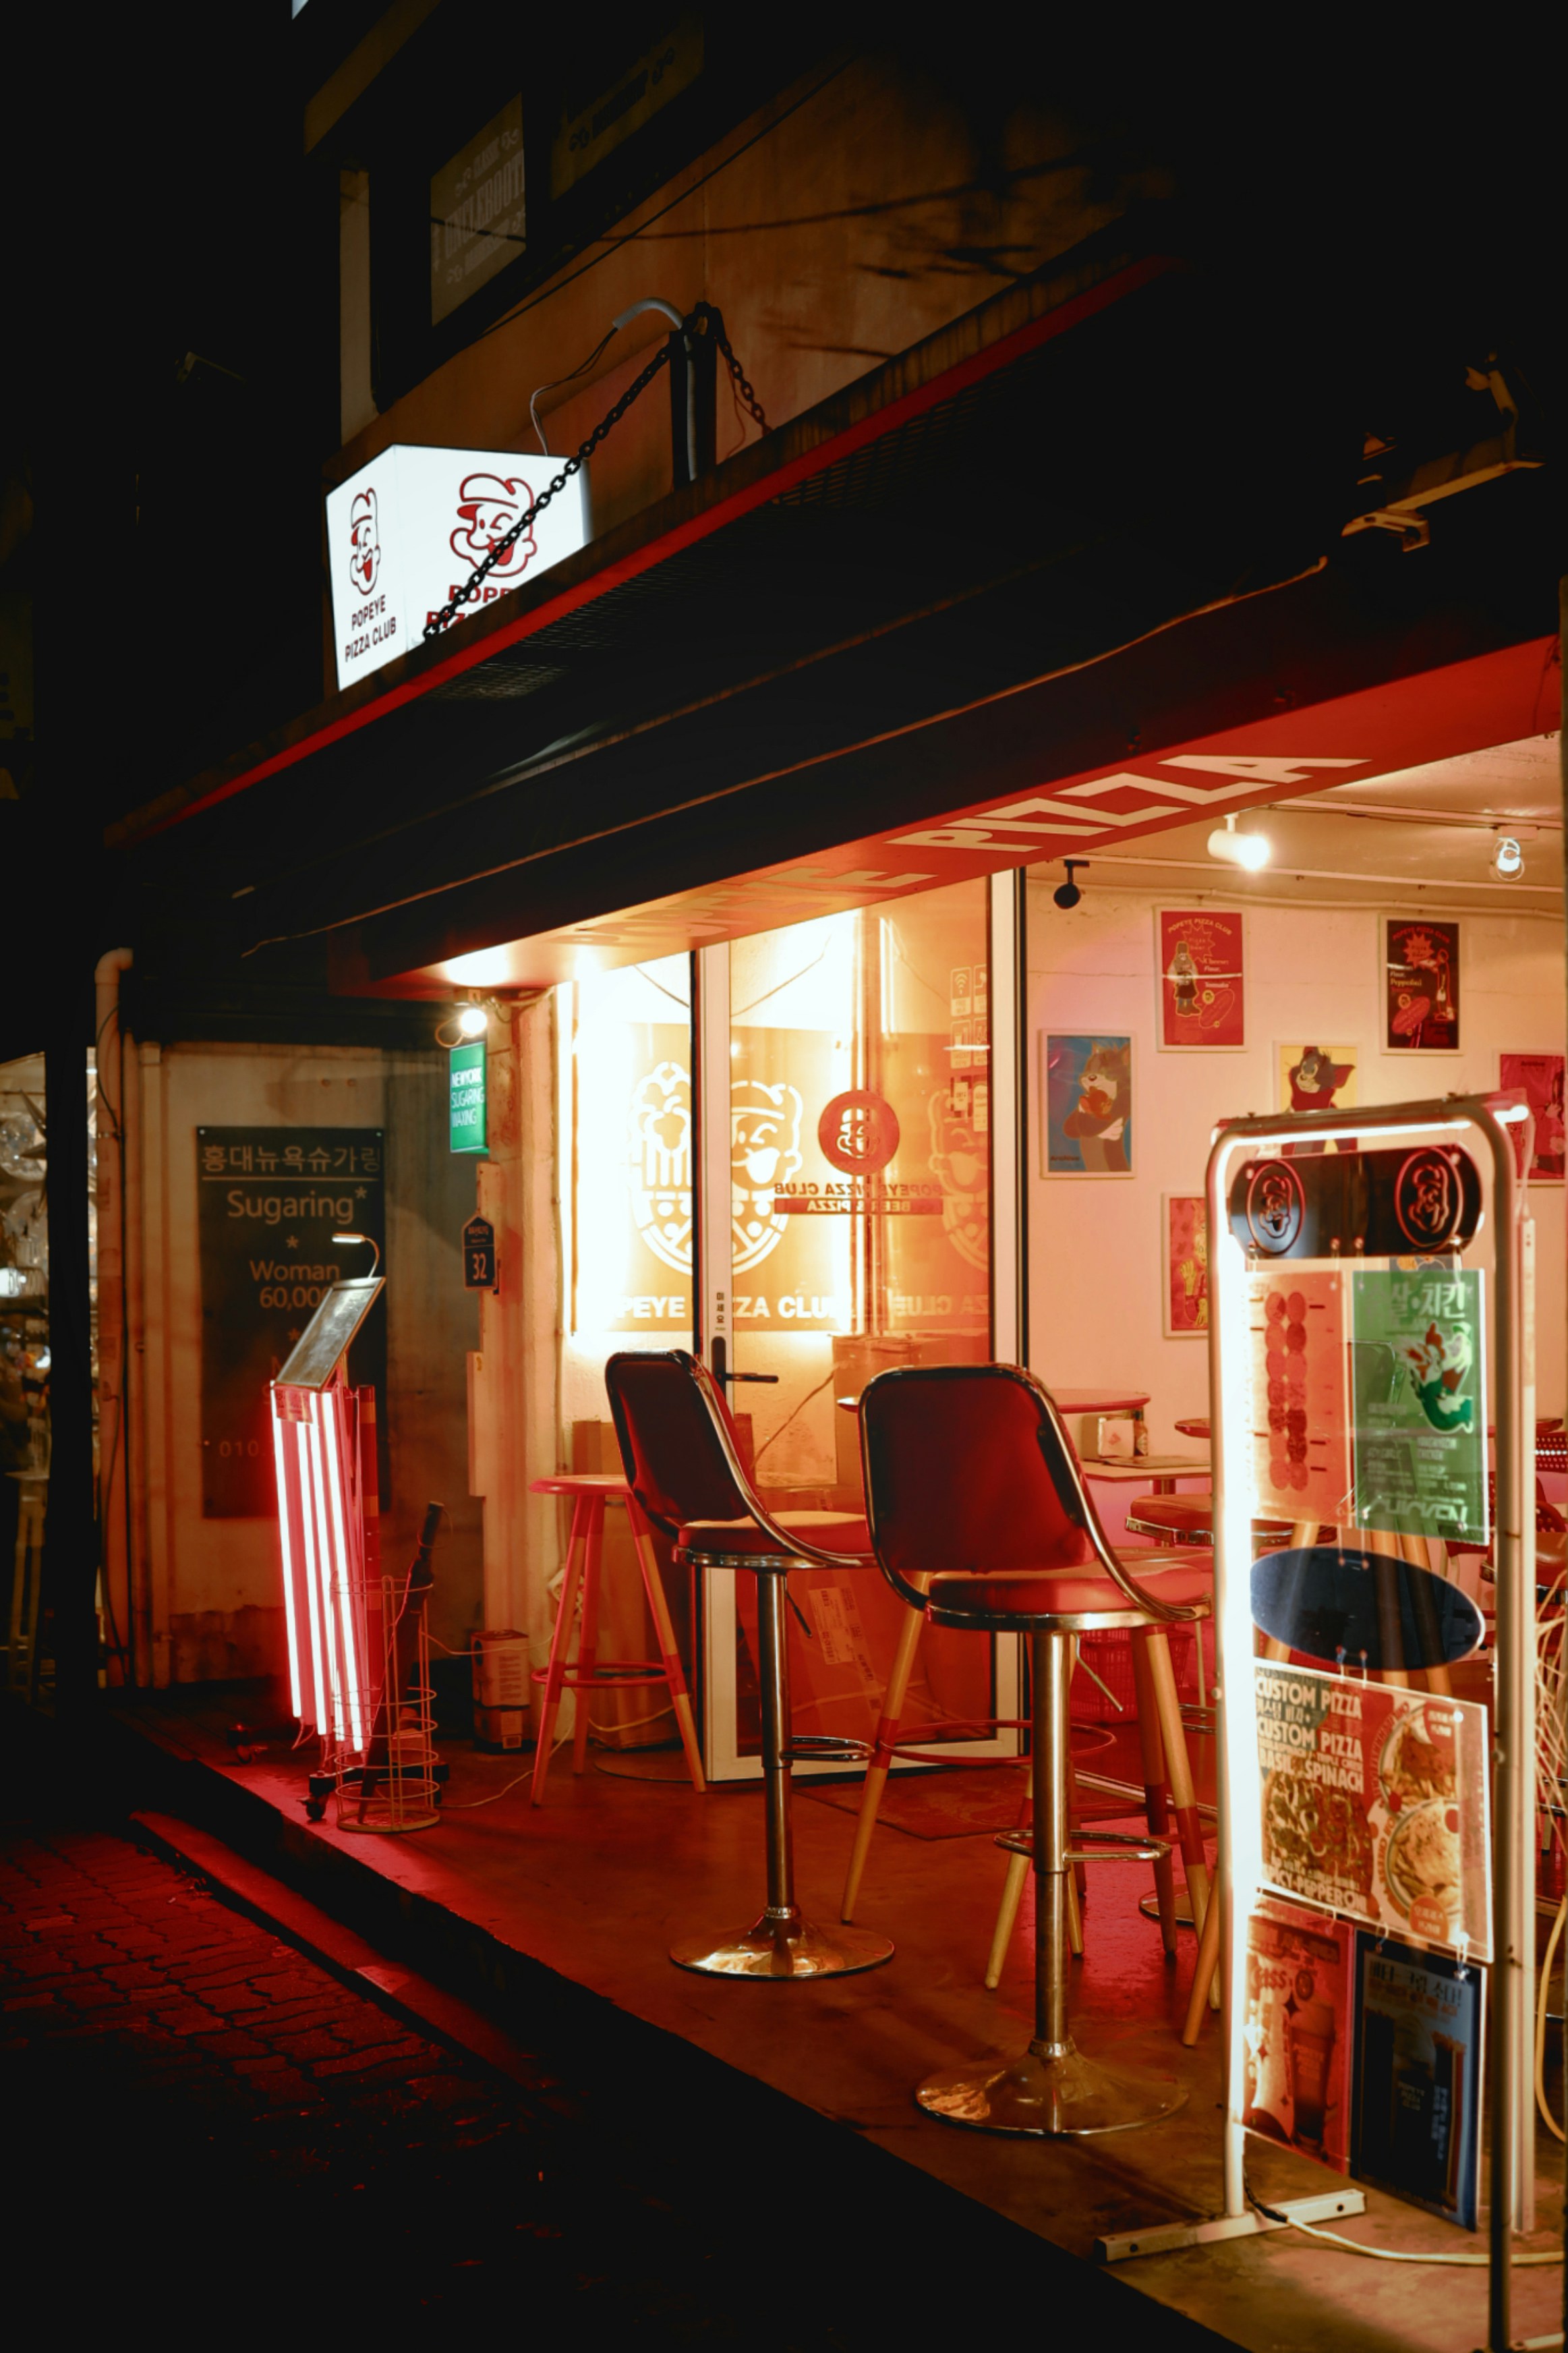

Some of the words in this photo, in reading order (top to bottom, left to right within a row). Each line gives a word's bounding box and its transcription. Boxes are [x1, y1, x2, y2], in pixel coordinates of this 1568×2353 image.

[351, 595, 386, 631] POPEYE
[345, 637, 370, 662] PIZZA
[372, 619, 397, 646] CLUB
[883, 754, 1372, 853] PIZZA
[1215, 922, 1232, 936] CLUB
[451, 1086, 485, 1108] SUGARING
[451, 1108, 477, 1128] WAXING
[202, 1145, 380, 1172] 홍대뉴욕슈가링
[250, 1260, 340, 1282] Woman
[472, 1253, 487, 1280] 32
[616, 1295, 685, 1317] PEYE
[716, 1292, 724, 1323] 미세요
[1256, 1676, 1316, 1708] CUSTOM
[1320, 1690, 1362, 1720] PIZZA
[1257, 1716, 1316, 1750] CUSTOM
[1320, 1731, 1362, 1761] PIZZA
[1260, 1748, 1295, 1776] BASIL
[1304, 1760, 1364, 1794] SPINACH
